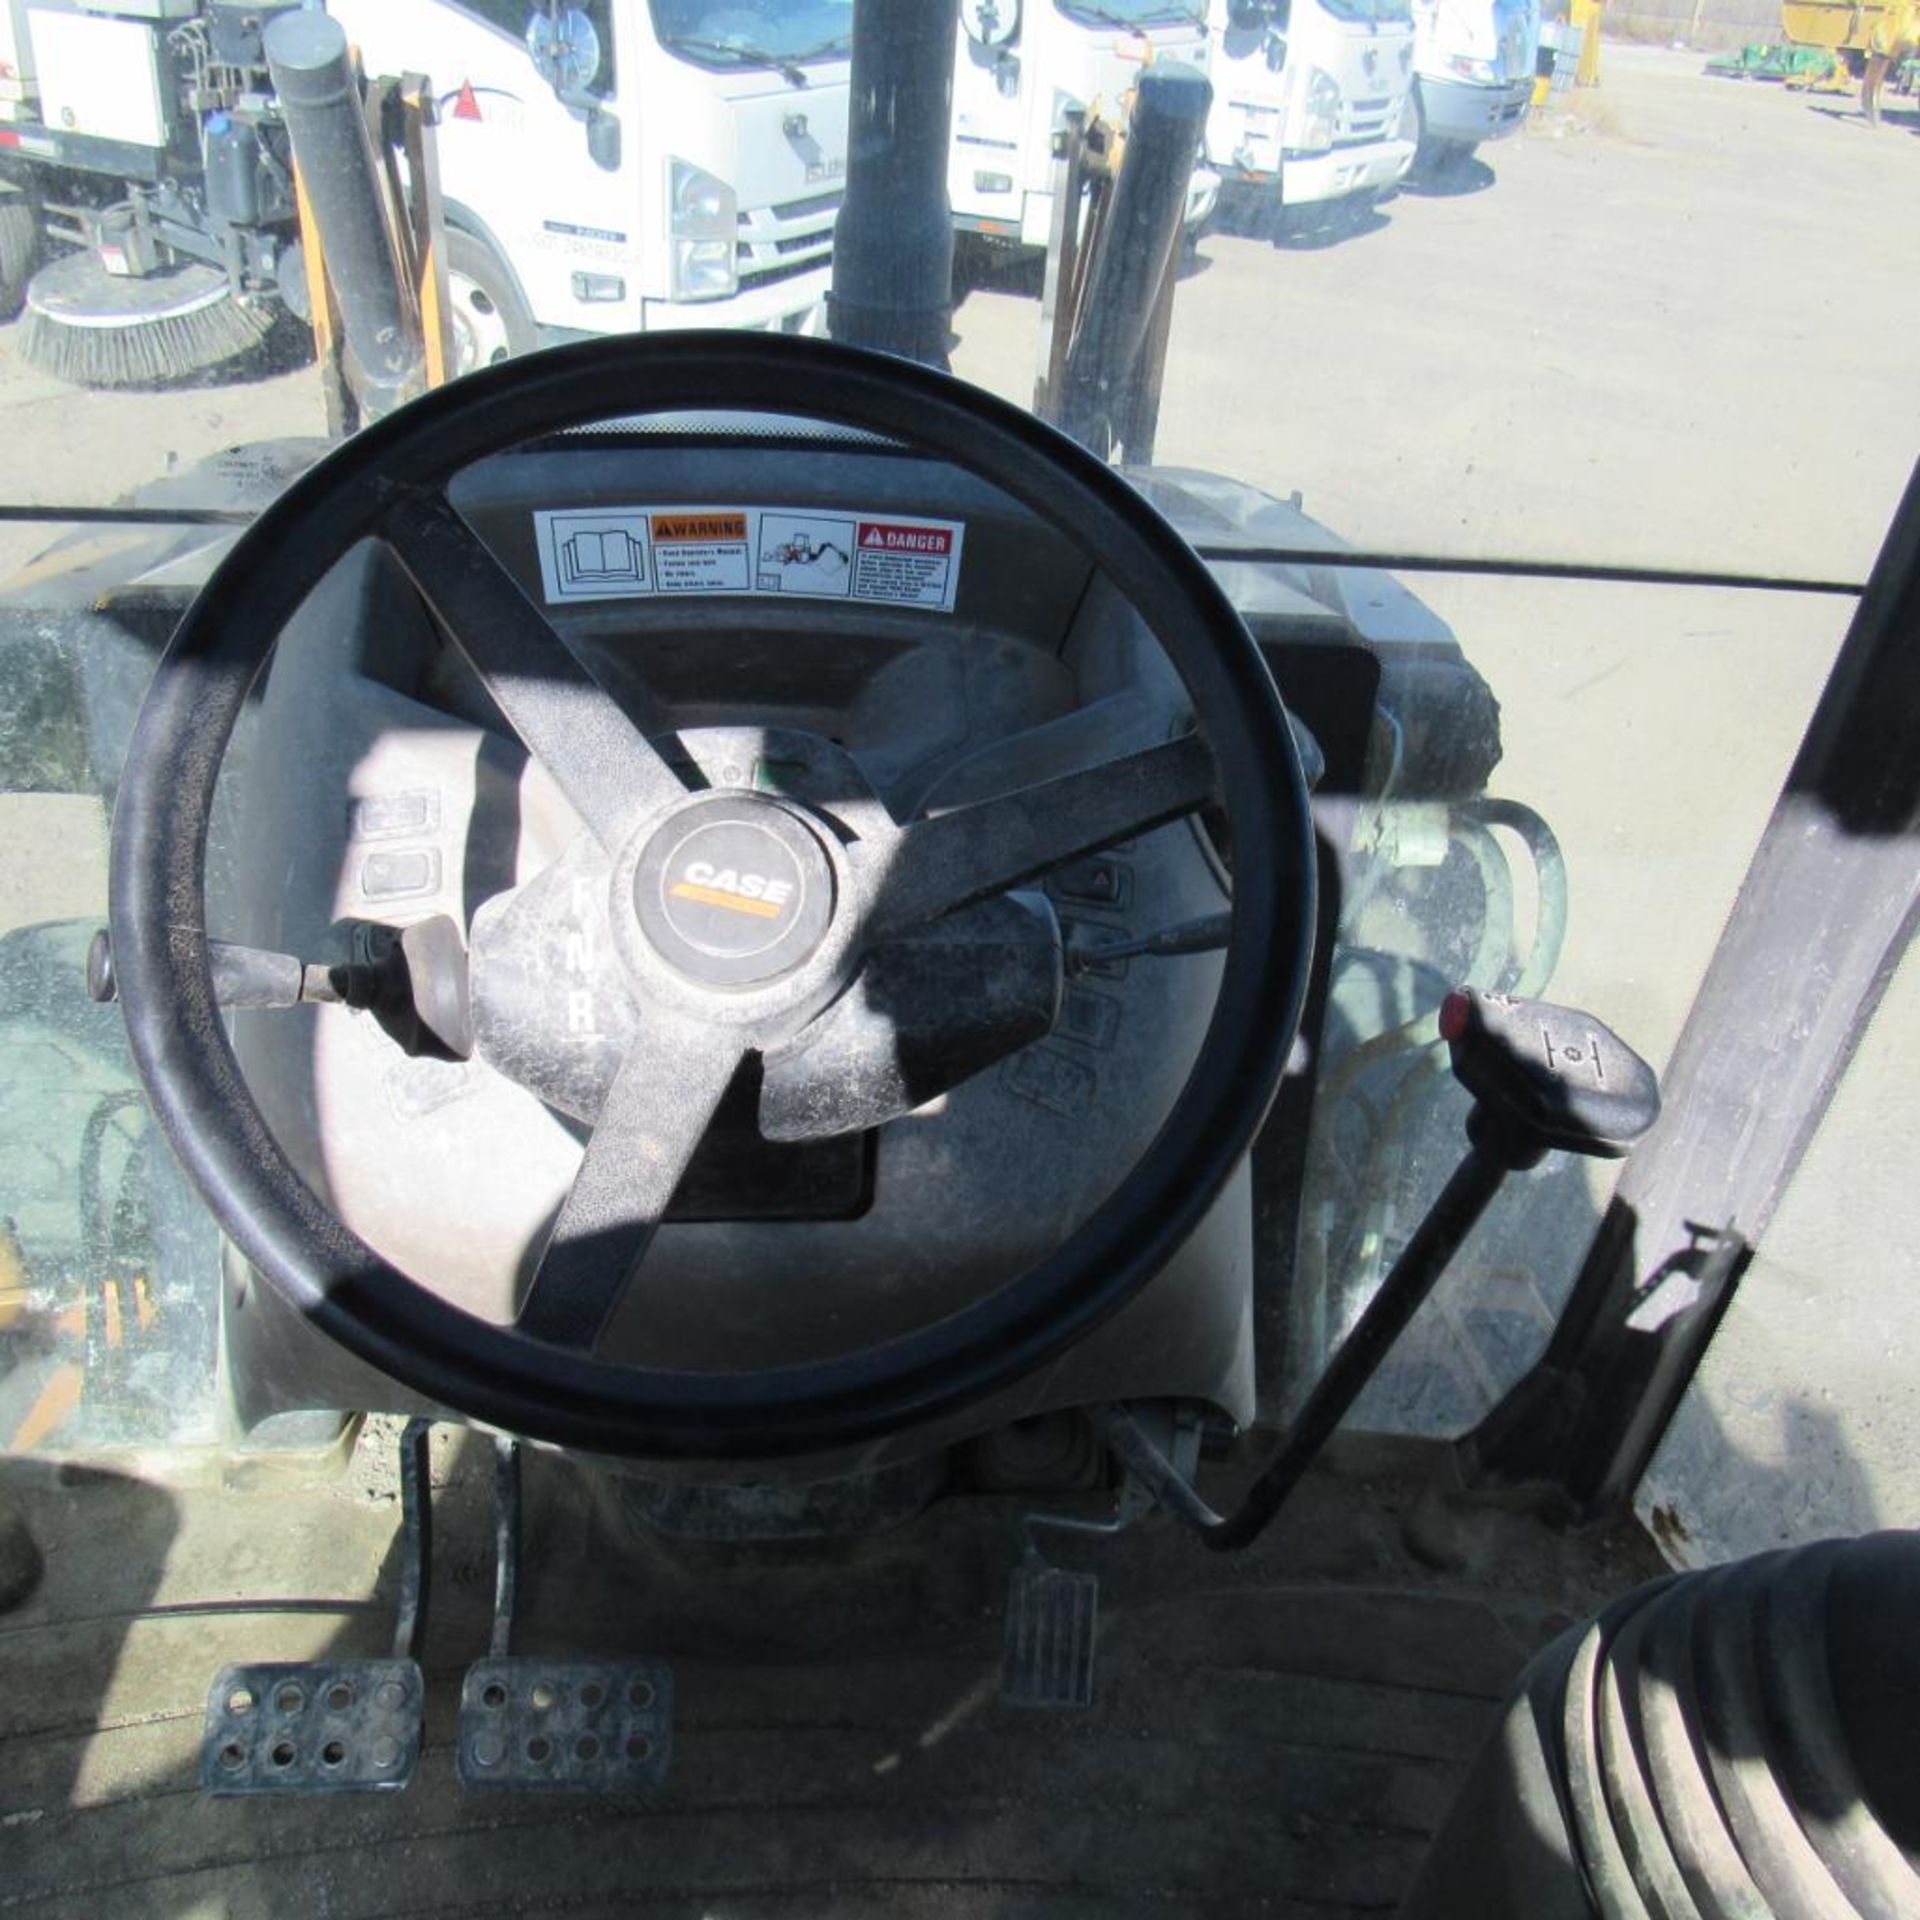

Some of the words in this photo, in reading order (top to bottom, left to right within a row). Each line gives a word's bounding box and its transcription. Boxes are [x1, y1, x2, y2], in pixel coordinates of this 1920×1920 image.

[673, 520, 745, 537] WARNING
[887, 532, 946, 551] DANGER
[572, 876, 593, 914] F
[685, 862, 793, 904] CASE
[567, 932, 593, 971] N
[569, 991, 595, 1032] R
